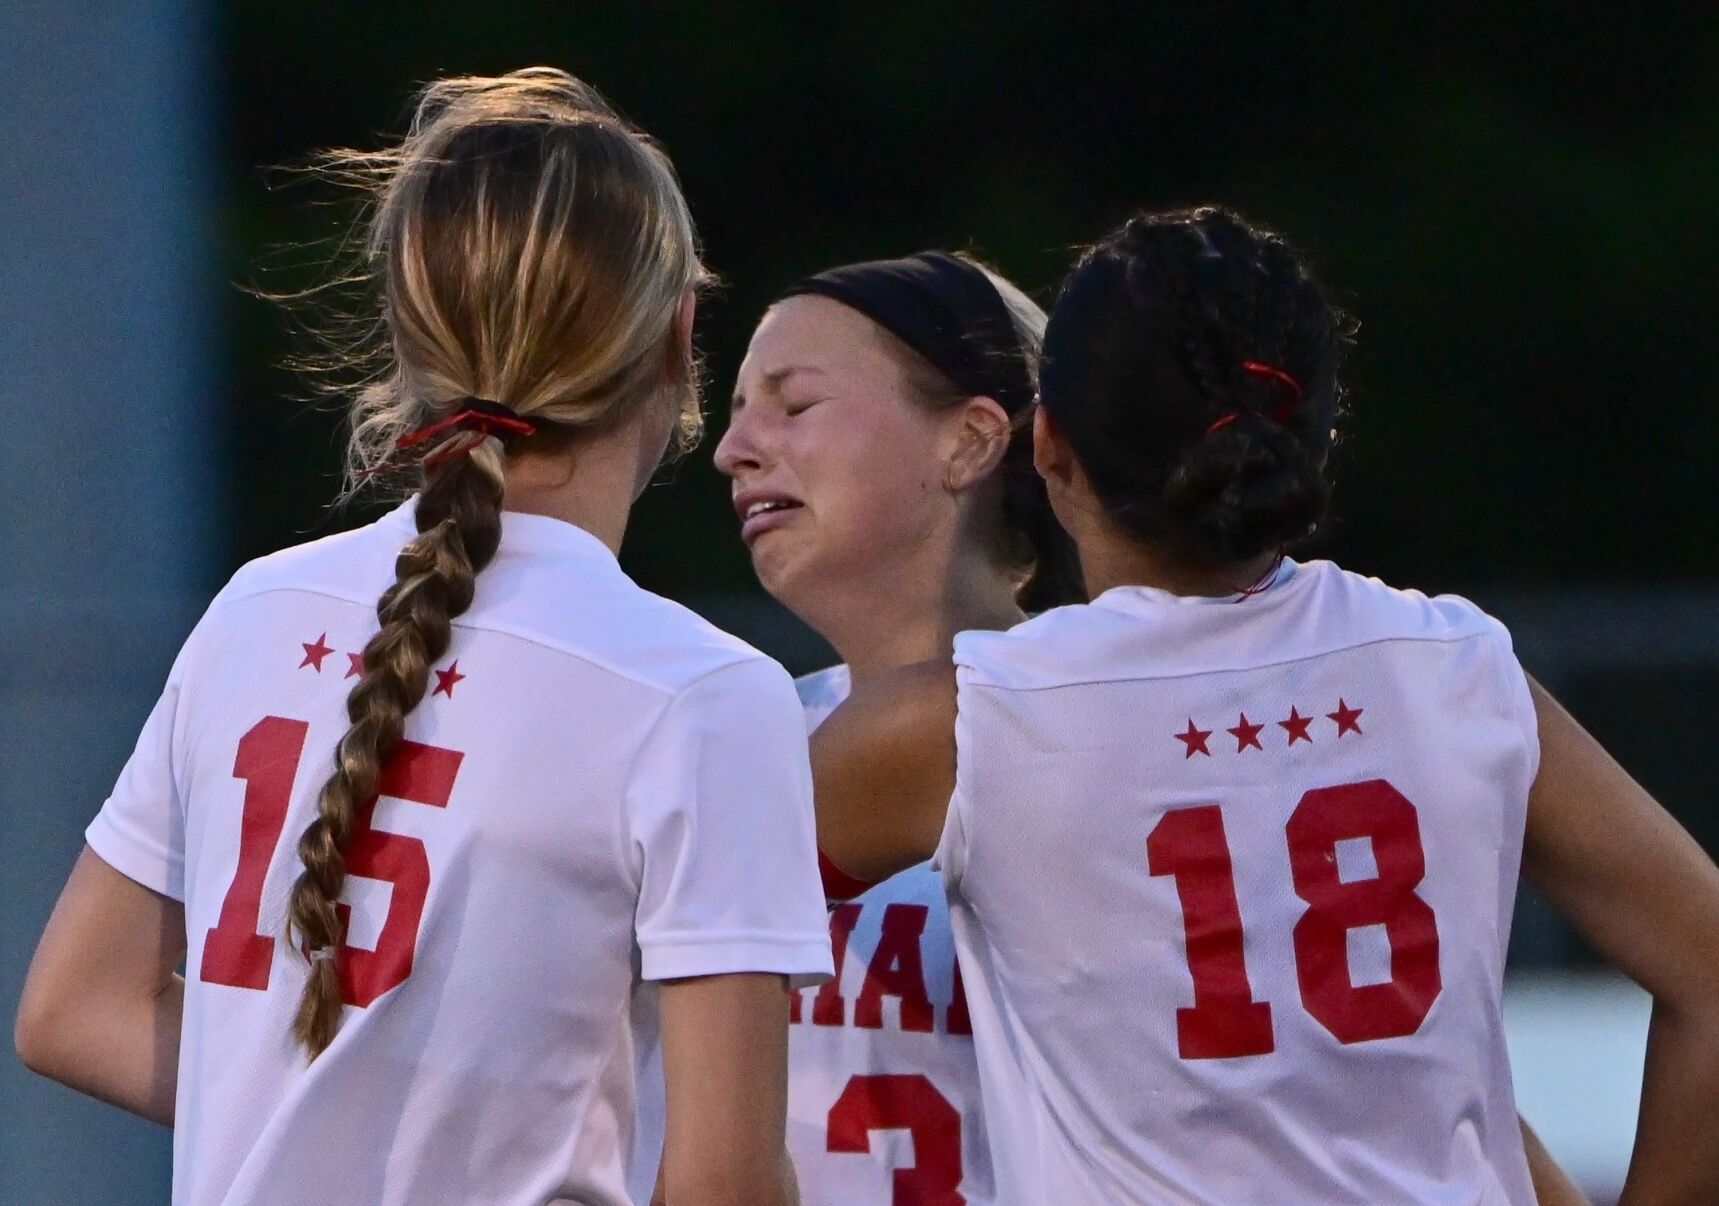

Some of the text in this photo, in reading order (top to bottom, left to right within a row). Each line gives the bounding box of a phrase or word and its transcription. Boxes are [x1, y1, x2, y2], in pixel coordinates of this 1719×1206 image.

[200, 715, 464, 1009] 15
[1146, 779, 1443, 1060] 18
[826, 1074, 967, 1206] 3
